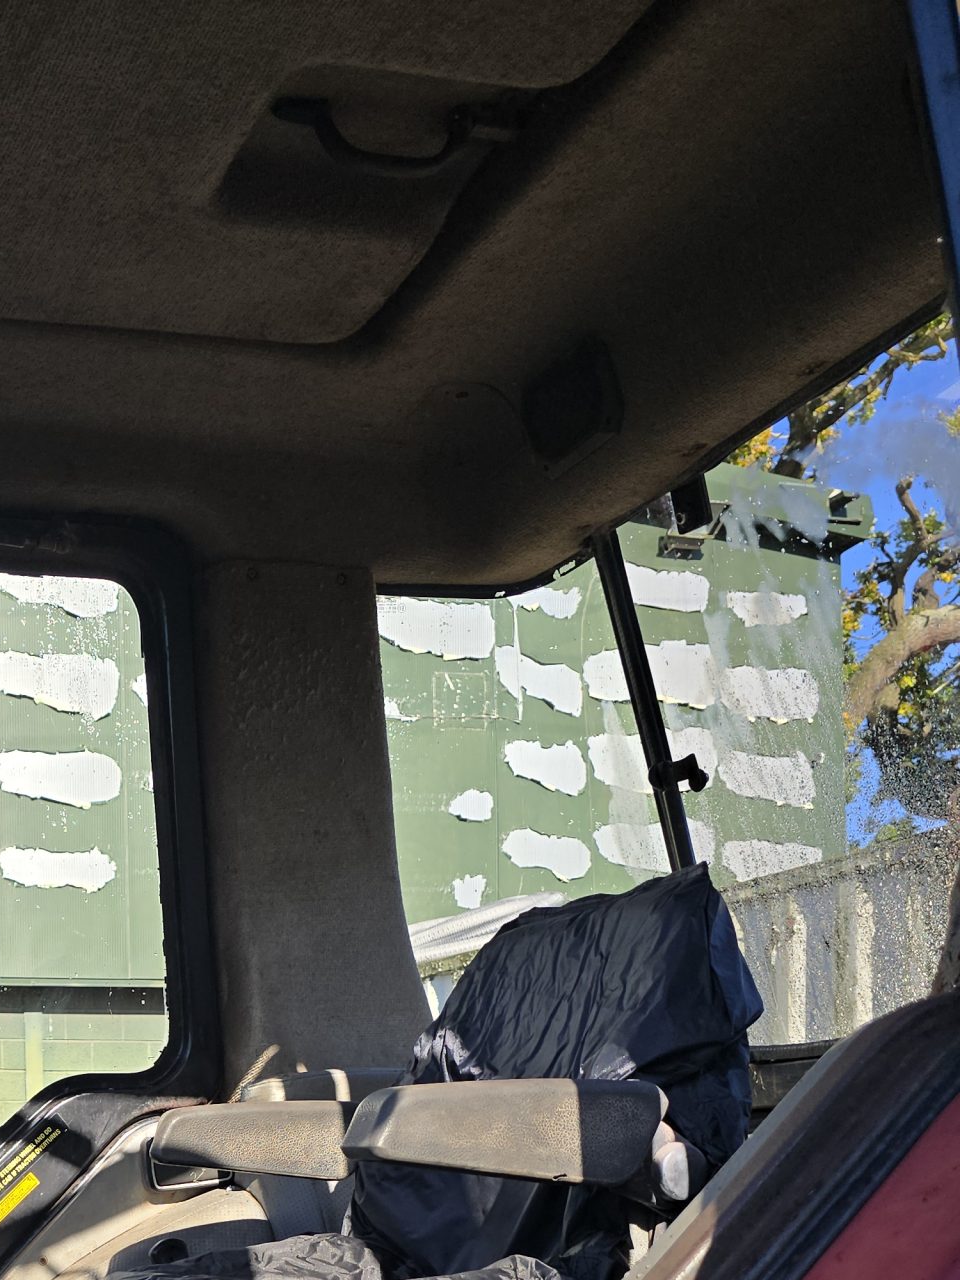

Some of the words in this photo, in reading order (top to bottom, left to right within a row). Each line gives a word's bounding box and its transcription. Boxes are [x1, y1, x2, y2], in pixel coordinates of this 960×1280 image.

[34, 1133, 45, 1144] AND
[44, 1127, 52, 1135] DO
[2, 1174, 13, 1185] CAB
[15, 1152, 37, 1172] TRACTOR
[34, 1128, 61, 1154] OVERTURNS
